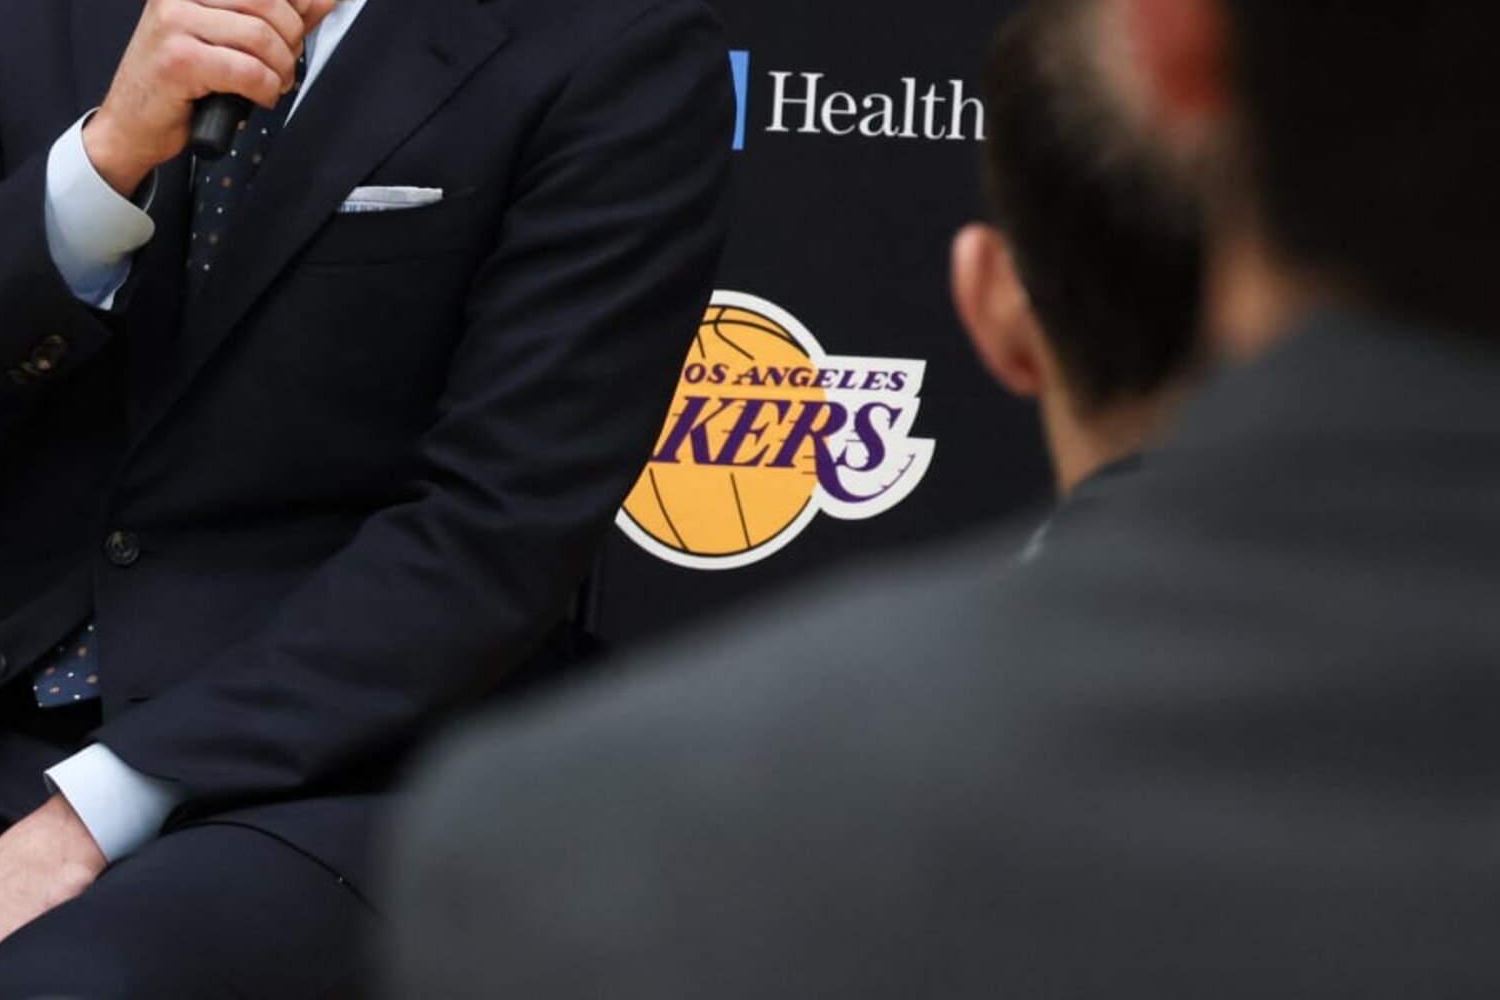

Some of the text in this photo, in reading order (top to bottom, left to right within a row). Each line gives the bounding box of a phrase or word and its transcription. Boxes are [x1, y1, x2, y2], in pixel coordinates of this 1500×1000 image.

[766, 71, 986, 141] Health
[683, 362, 908, 392] OS ANGELES
[650, 396, 916, 503] KERS
